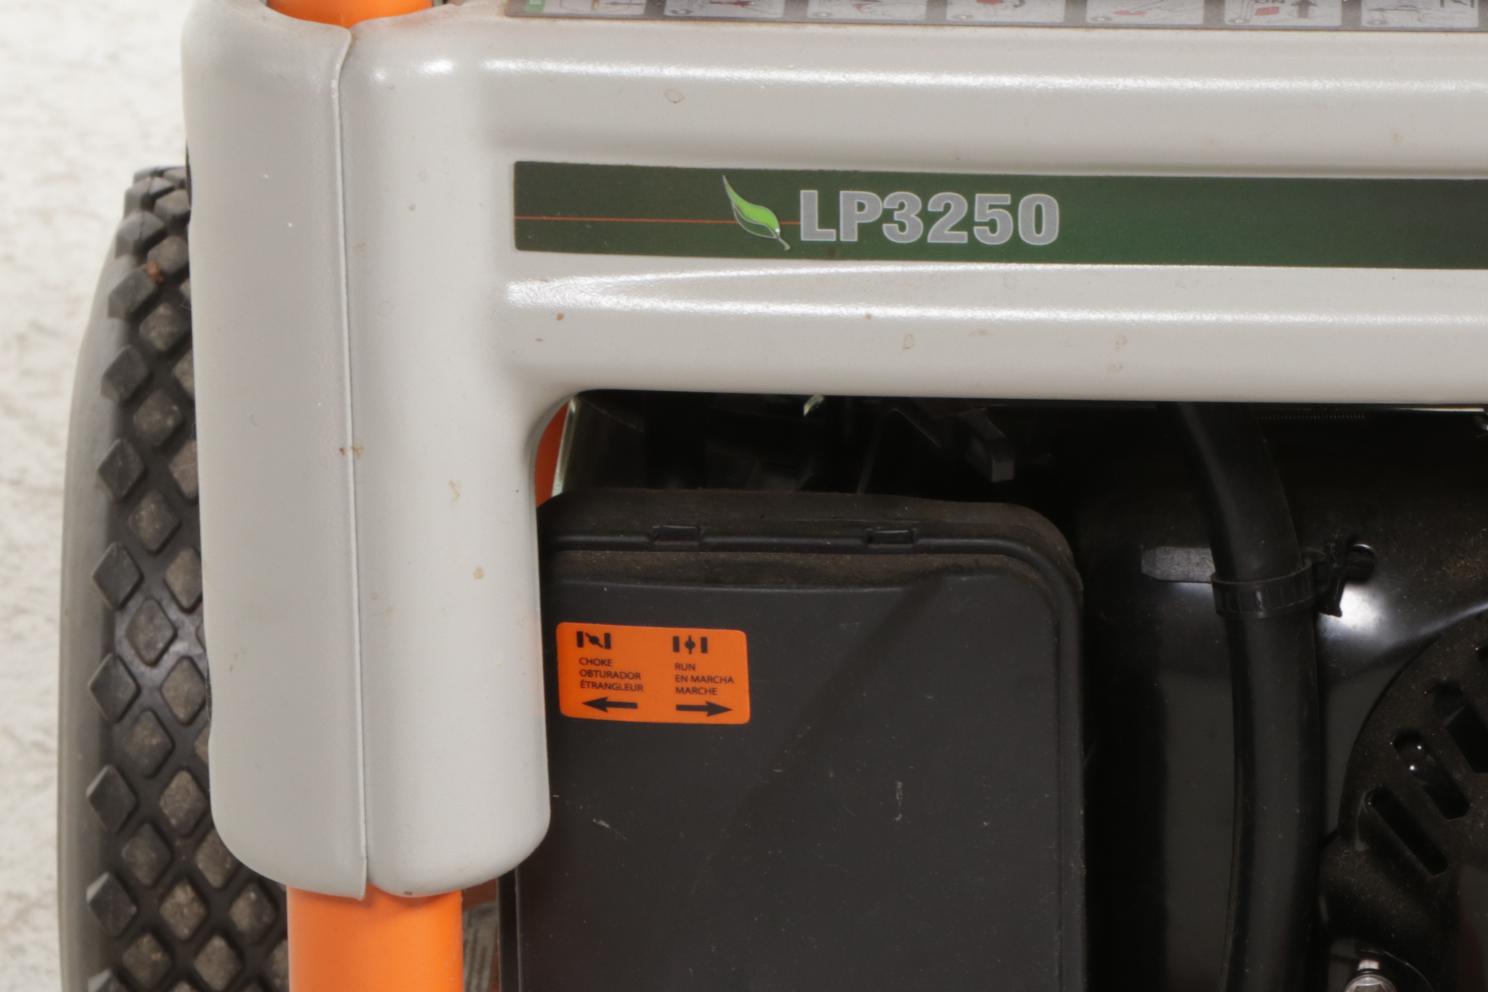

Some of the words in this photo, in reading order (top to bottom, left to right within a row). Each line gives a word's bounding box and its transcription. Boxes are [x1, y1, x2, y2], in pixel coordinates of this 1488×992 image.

[799, 189, 1060, 246] LP3250
[578, 656, 613, 667] CHOKE
[674, 662, 696, 671] RUN
[579, 669, 642, 681] OBTURADOR
[674, 674, 688, 683] EN
[690, 674, 735, 684] MARCHA
[579, 679, 644, 692] ÉTRANGLEUR
[675, 686, 718, 696] MARCHE
